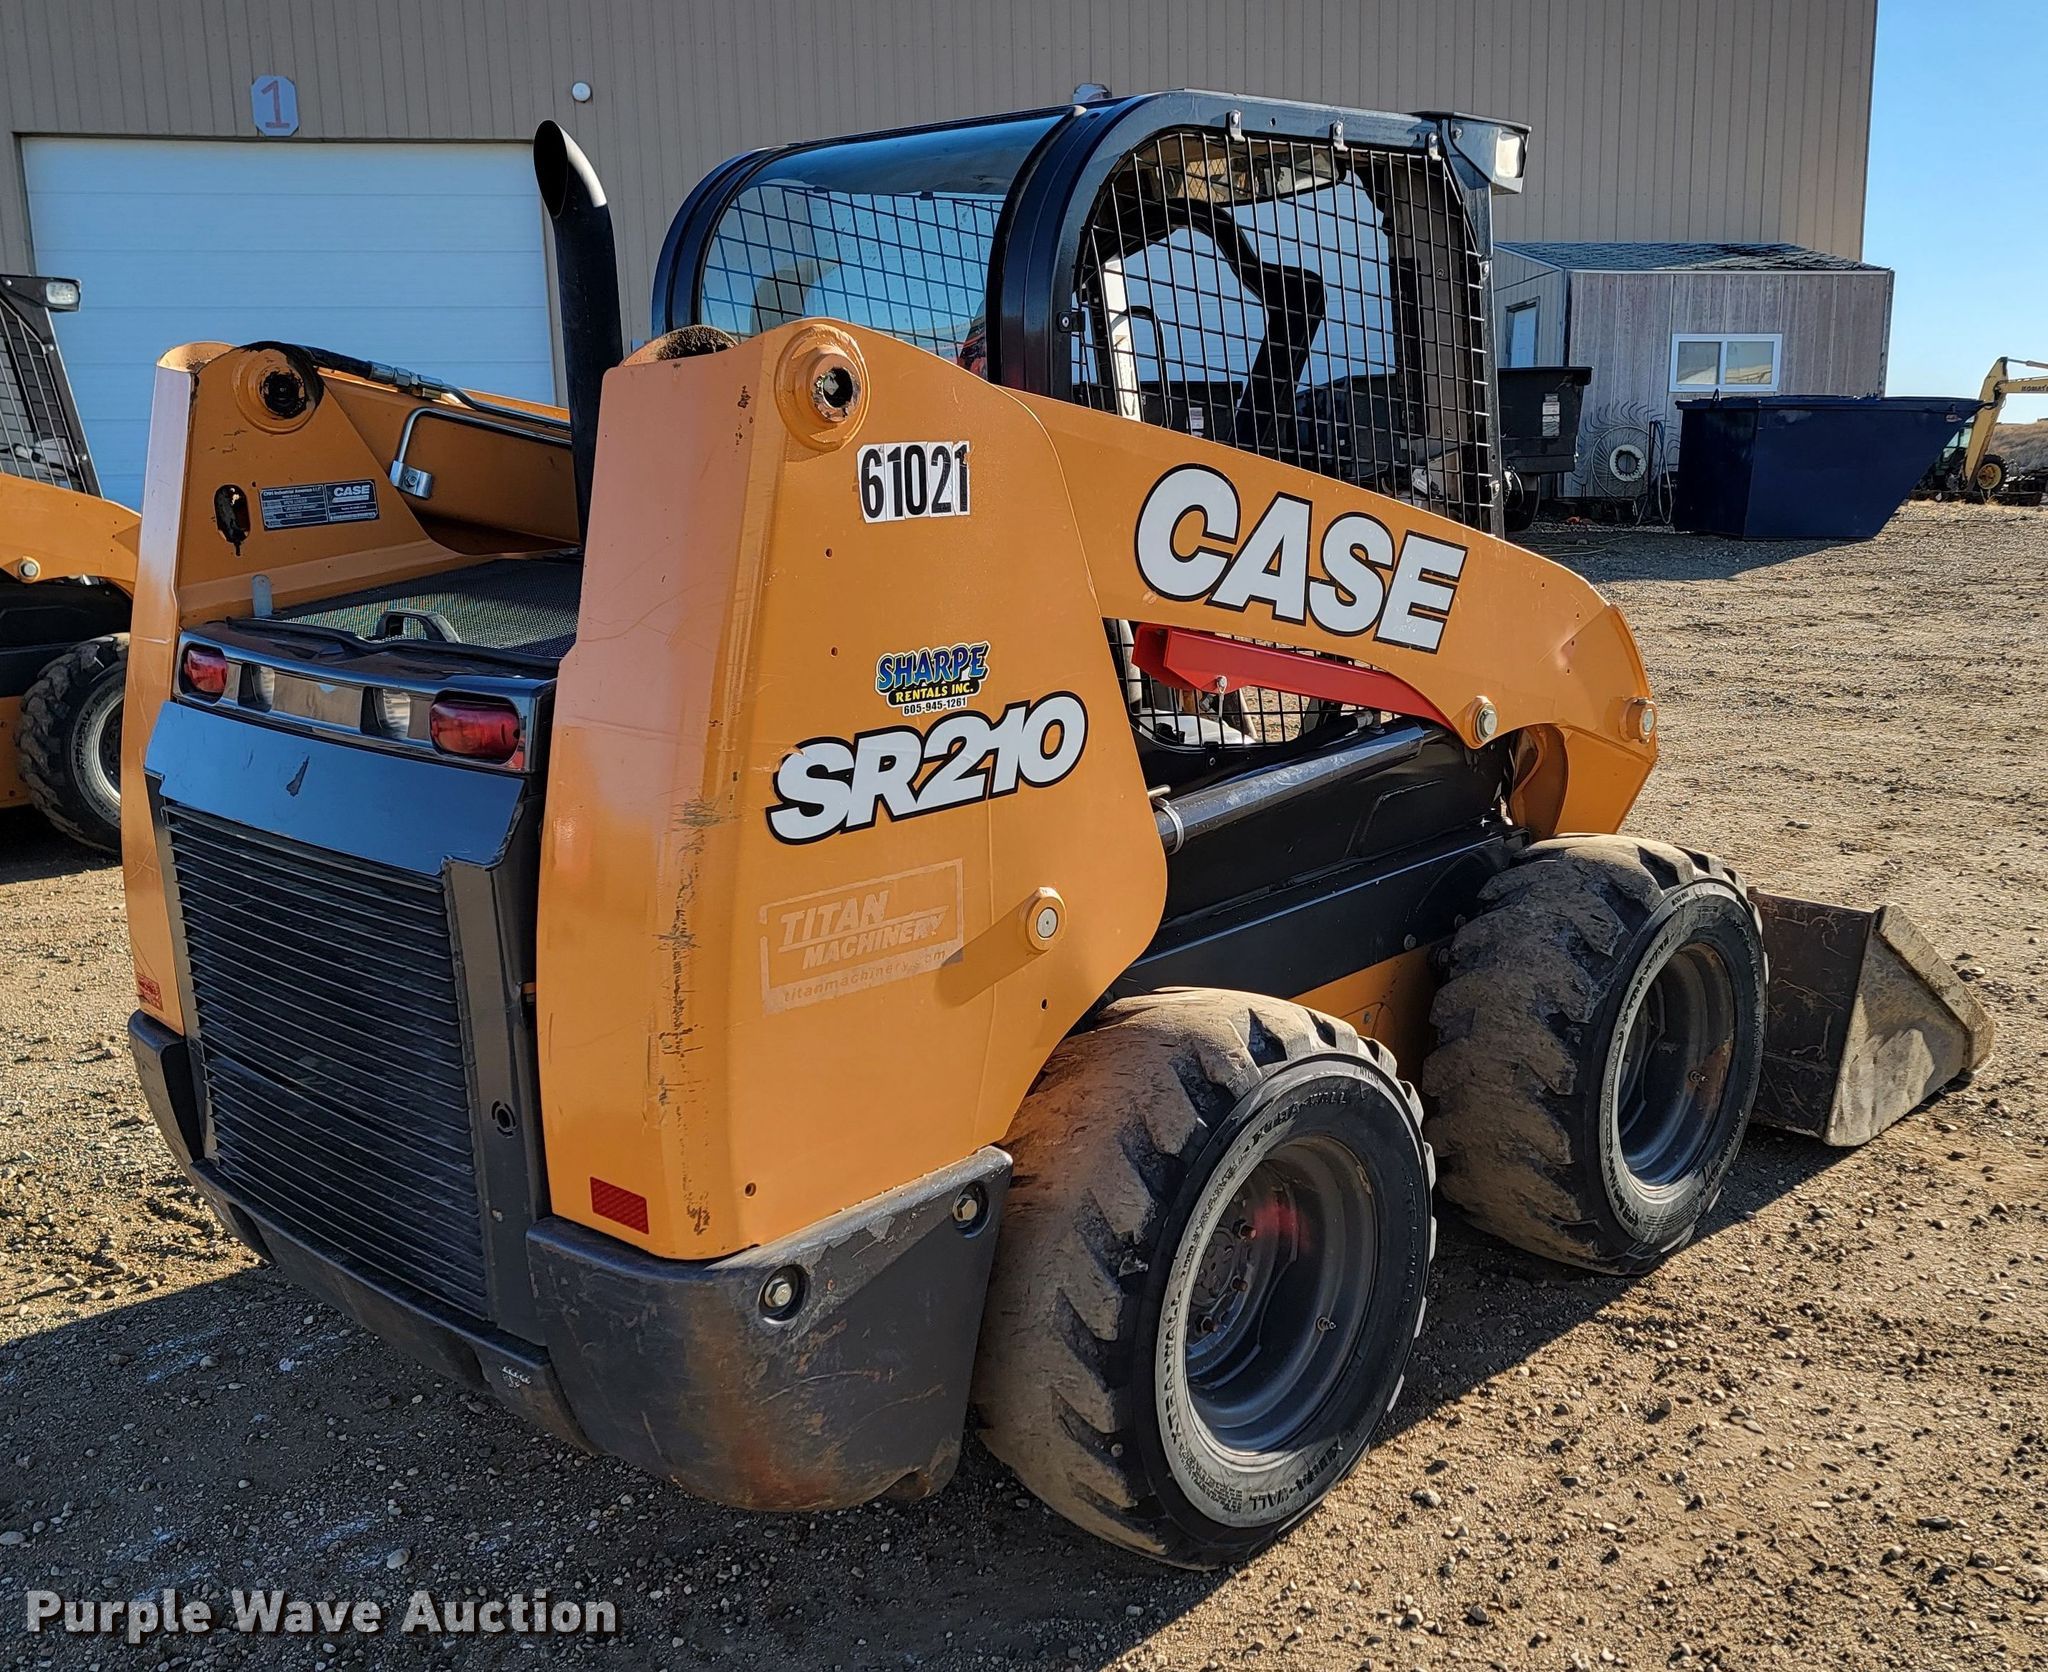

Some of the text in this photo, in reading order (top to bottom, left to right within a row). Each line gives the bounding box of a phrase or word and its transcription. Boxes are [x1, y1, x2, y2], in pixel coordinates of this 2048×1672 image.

[260, 79, 291, 129] 1
[333, 484, 371, 497] CASE
[860, 443, 969, 519] 61021
[1133, 462, 1469, 655] CASE
[876, 642, 988, 692] SHARPE
[895, 682, 974, 703] RENTALS INC.
[903, 696, 967, 715] 605-945-1261
[764, 690, 1089, 846] SR210
[780, 890, 889, 946] TITAN
[802, 912, 945, 970] MACHINERY
